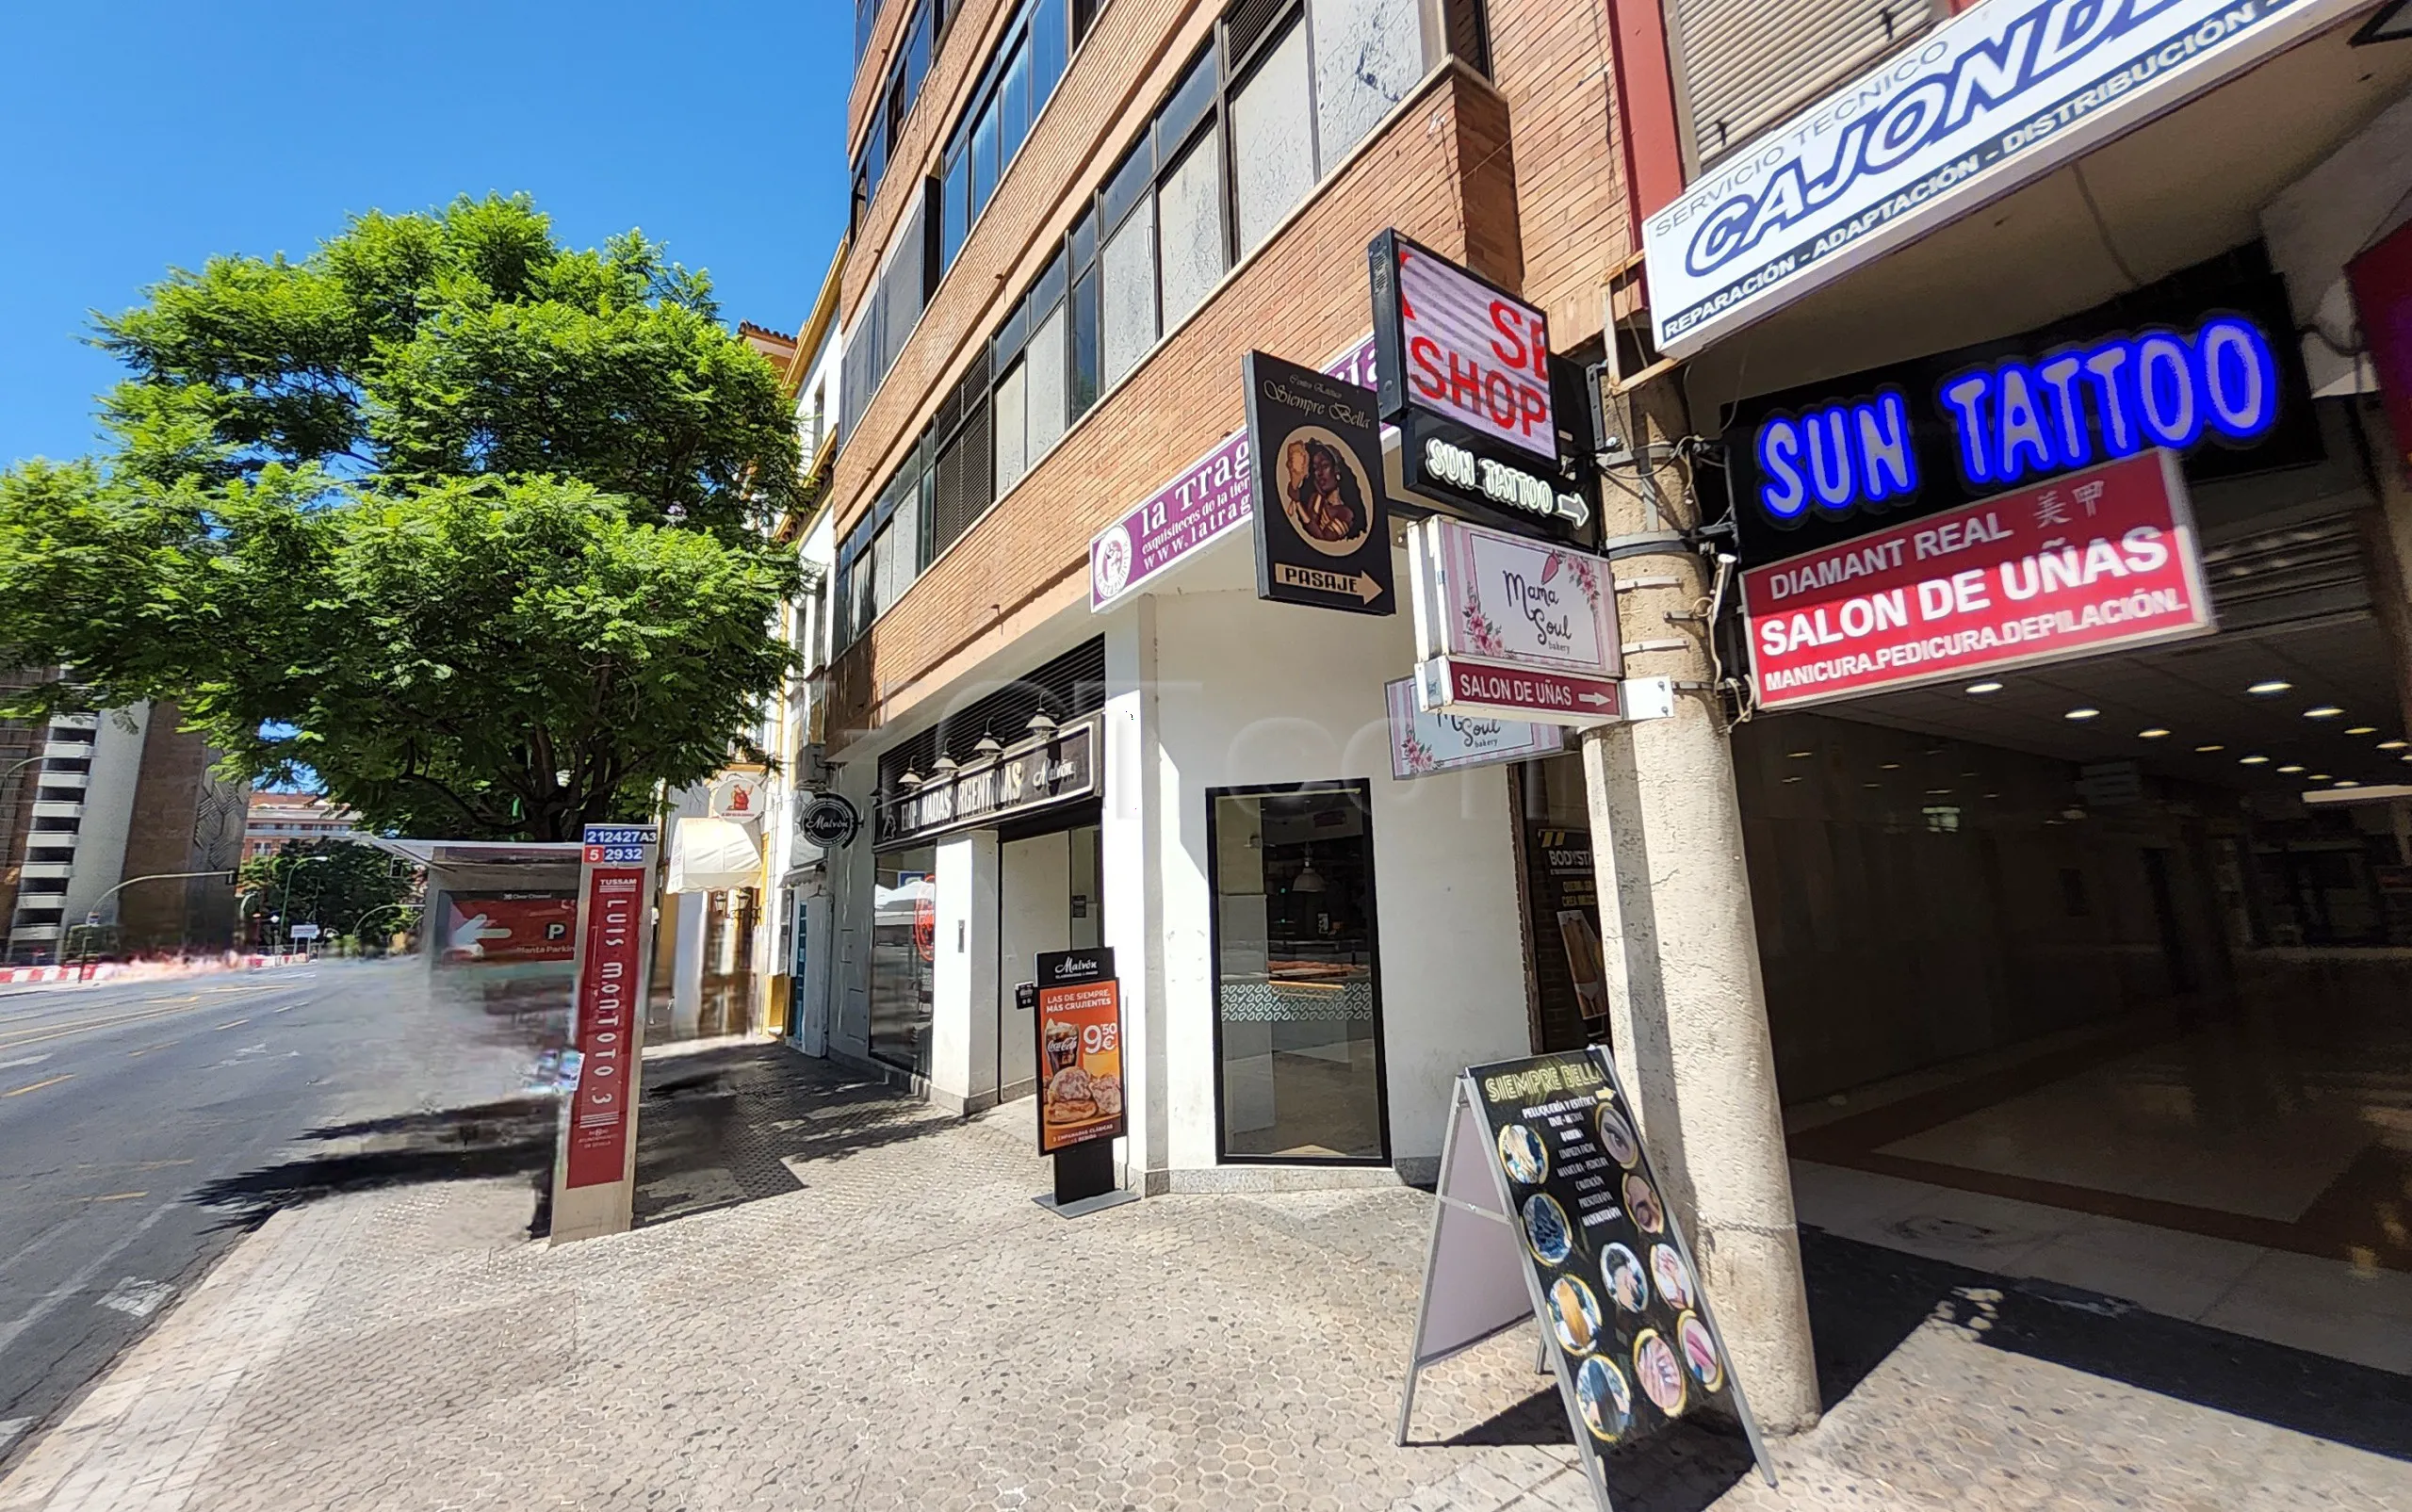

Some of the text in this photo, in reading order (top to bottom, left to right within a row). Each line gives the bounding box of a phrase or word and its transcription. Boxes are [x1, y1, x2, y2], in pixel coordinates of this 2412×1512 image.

[1655, 41, 1948, 238] SERVICIO TECNICO
[1686, 0, 2184, 277] CAJOND
[1665, 254, 1796, 339] REPARACIÓN
[1812, 154, 1980, 261] ADAPTACIÓN
[2002, 3, 2257, 155] DISTRIBUCIÓN
[1263, 379, 1372, 430] Siempre Bella
[1410, 335, 1546, 437] SHOP
[1757, 320, 2269, 518] SUN TATTOO
[1426, 436, 1555, 514] SUN TATTOO
[1141, 500, 1167, 538] la
[1770, 513, 2013, 601] DIAMANT REAL
[1285, 567, 1358, 593] PASAJE
[1503, 570, 1559, 614] Mama
[1760, 525, 2169, 657] SALON DE UÑAS
[1532, 610, 1572, 645] Soul
[1460, 675, 1572, 707] SALON DE UÑAS
[589, 849, 599, 861] 5
[548, 924, 565, 939] P
[605, 900, 627, 946] LUIS
[1055, 956, 1098, 974] Malvón
[1046, 998, 1112, 1014] MÁS CRUJIENTES
[1047, 995, 1063, 1004] LAS
[1064, 993, 1075, 1002] DE
[1485, 1067, 1562, 1102] SIEMPRE
